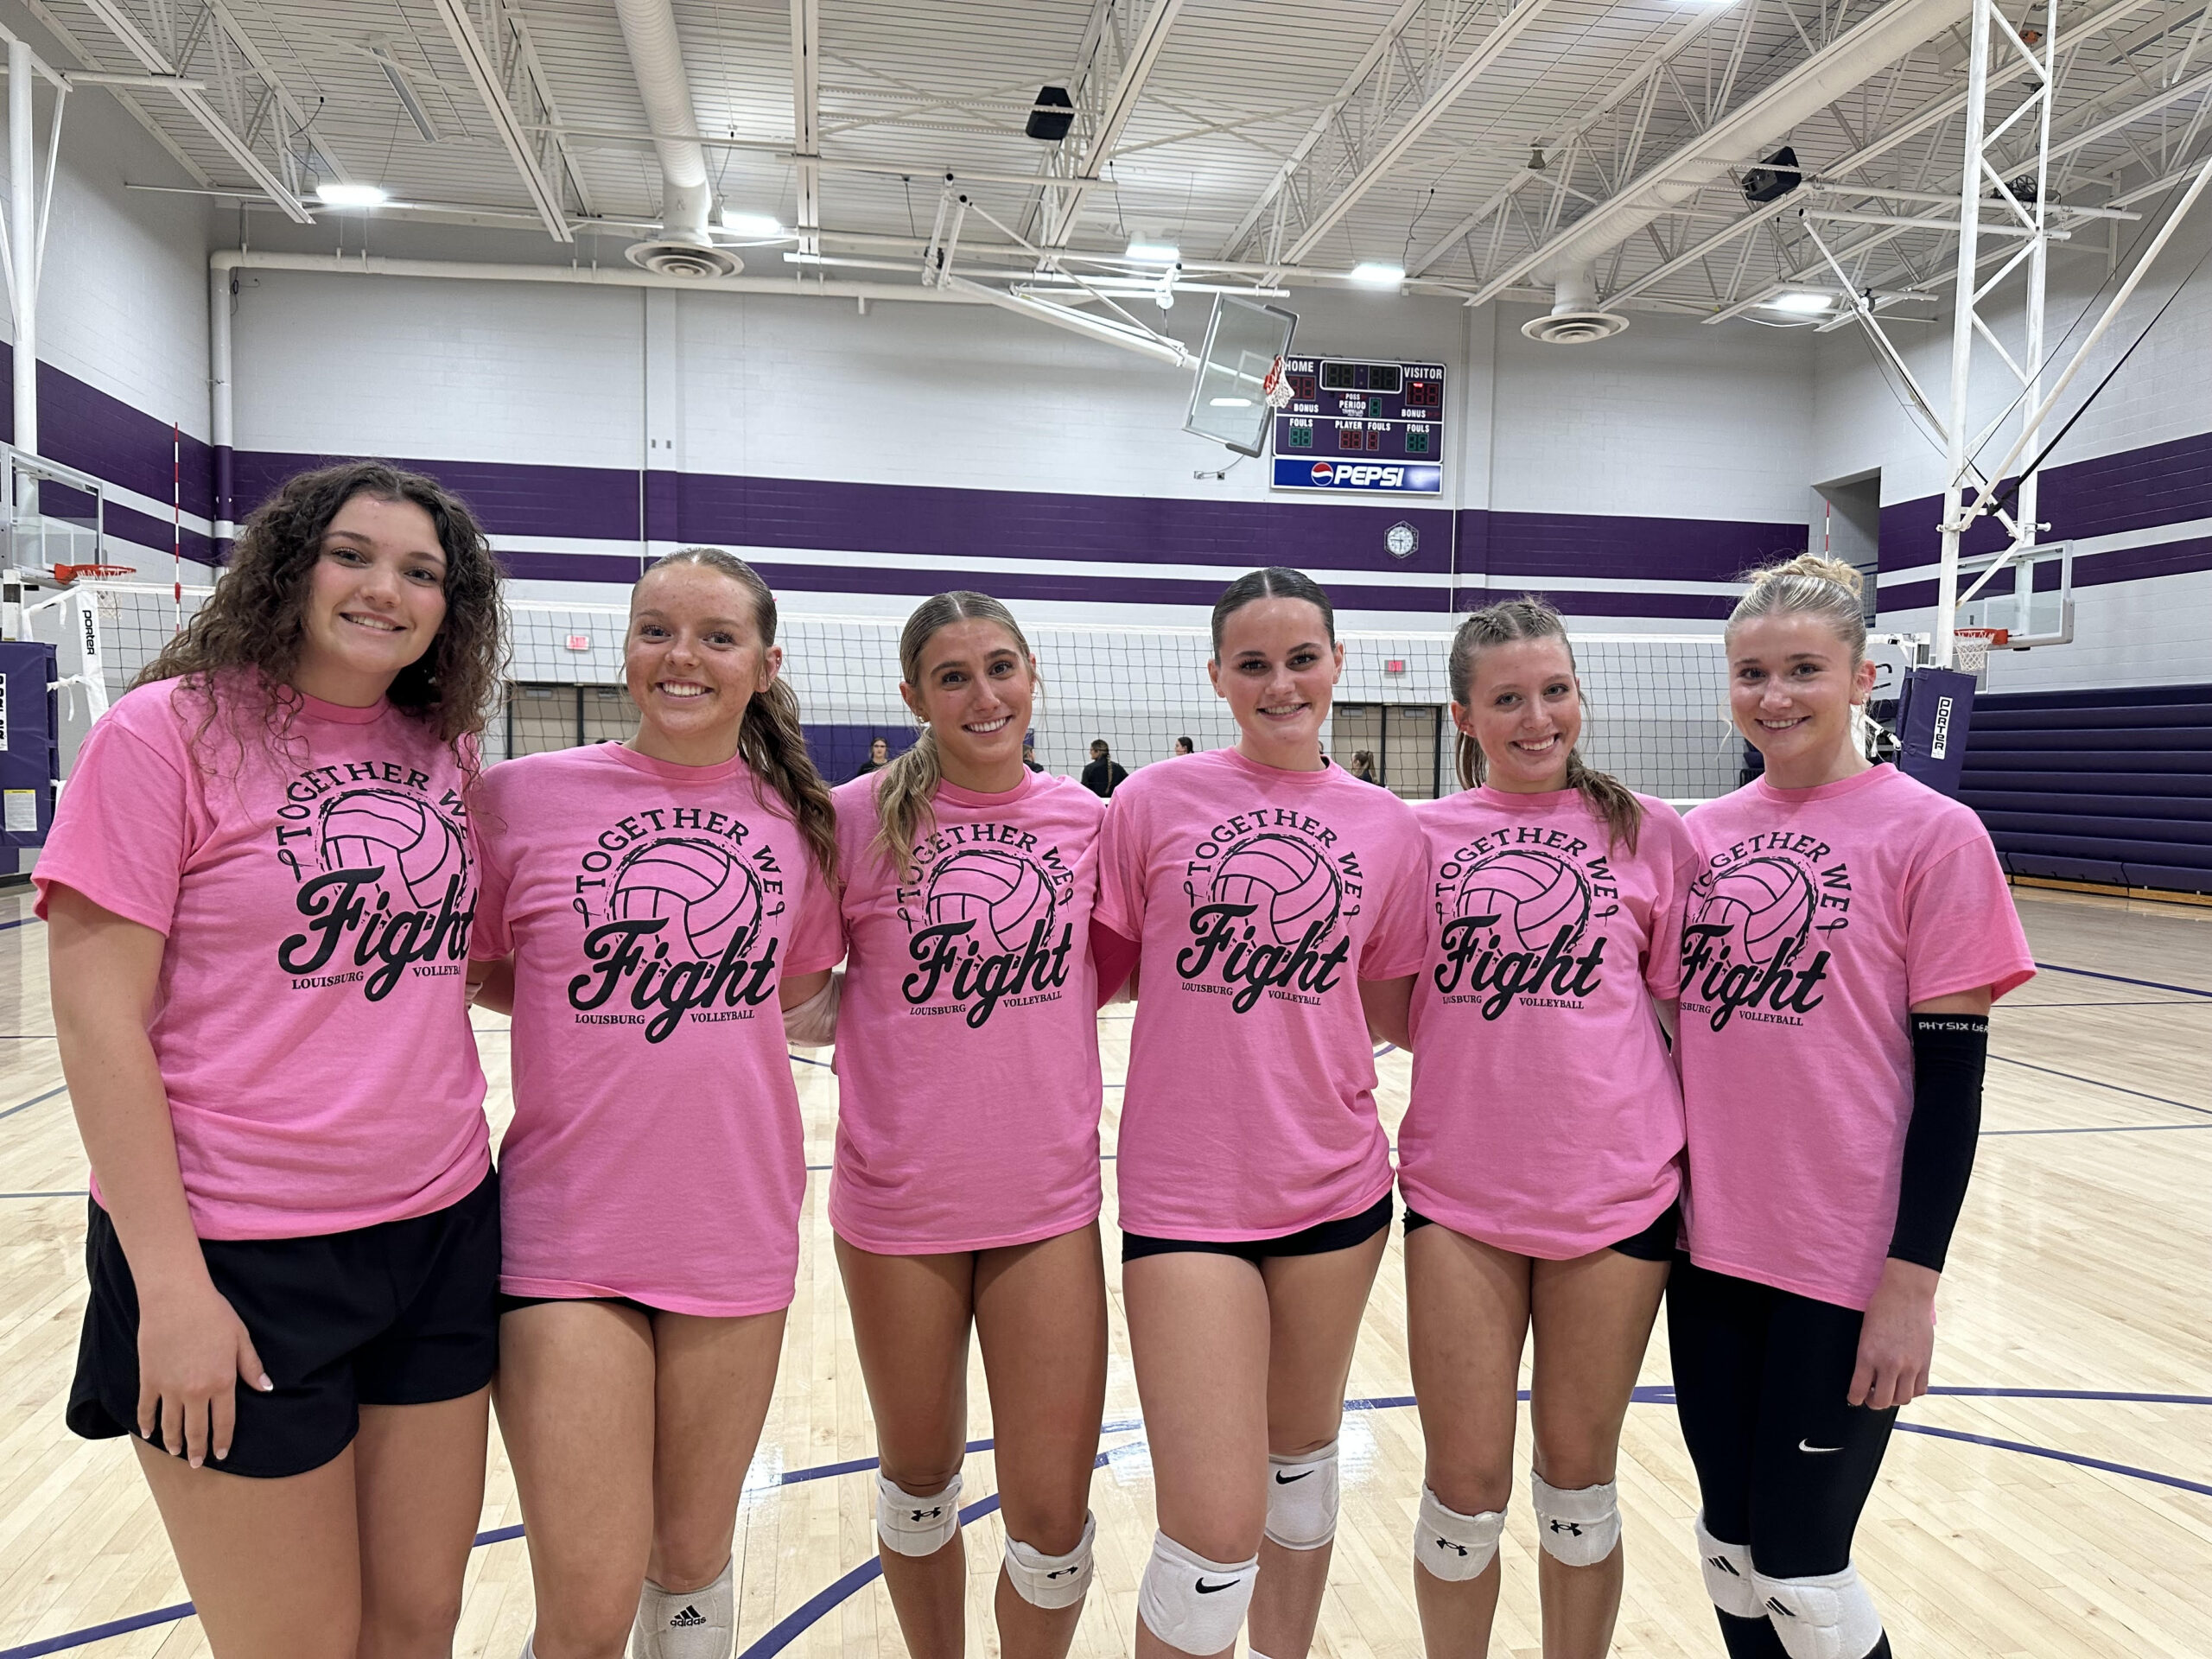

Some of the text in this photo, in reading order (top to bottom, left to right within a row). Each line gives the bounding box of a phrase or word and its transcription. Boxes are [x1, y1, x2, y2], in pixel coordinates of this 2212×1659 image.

[1285, 360, 1313, 372] HOME
[1404, 367, 1442, 379] VISITOR
[1294, 404, 1319, 413] BONUS
[1339, 400, 1366, 410] PERIOD
[1401, 409, 1426, 418] BONUS
[1290, 418, 1313, 427] FOULS
[1335, 421, 1391, 431] PLAYER FOULS
[1407, 423, 1430, 433] FOULS
[1333, 465, 1404, 487] PEPSI
[276, 761, 430, 846] TOGETHER
[575, 808, 784, 896] TOGETHER WE
[1187, 808, 1363, 899] TOGETHER WE
[1435, 827, 1618, 899] TOGETHER WE
[896, 823, 1074, 904] TOGETHER WE
[1690, 831, 1852, 912] TOGETHER WE
[278, 865, 477, 1001] Fight
[1176, 903, 1351, 1014] Fight
[1434, 913, 1607, 1021] Fight
[292, 970, 364, 989] LOUISBURG
[568, 917, 779, 1044] Fight
[901, 918, 1073, 1029] Fight
[1680, 924, 1831, 1033] Fight
[910, 991, 1062, 1015] LOUISBURG VOLLEYBALL
[1181, 982, 1321, 1006] LOUISBURG VOLLEYBALL
[1519, 997, 1584, 1009] VOLLEYBALL
[575, 1009, 755, 1025] LOUISBURG VOLLEYBALL
[1738, 1010, 1803, 1027] VOLLEYBALL
[1918, 1021, 1969, 1031] PHYSIX
[670, 1616, 707, 1628] adidas
